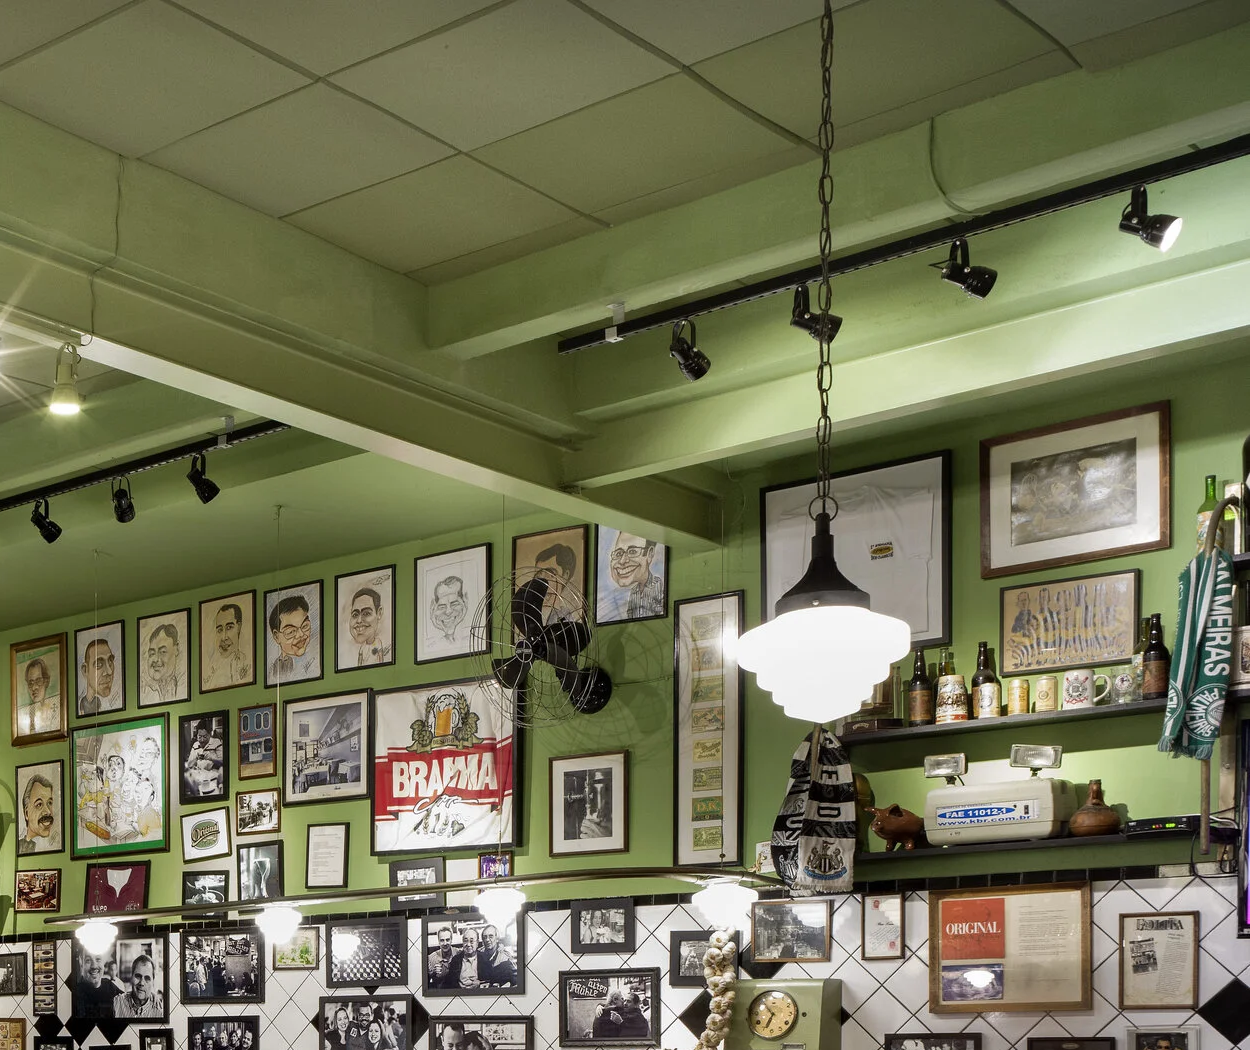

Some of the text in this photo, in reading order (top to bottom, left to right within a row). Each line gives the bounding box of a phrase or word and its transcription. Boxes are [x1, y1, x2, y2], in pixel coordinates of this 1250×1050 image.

[945, 807, 1007, 819] FAE 11012-1
[937, 815, 1031, 827] www.kbr.com.br
[945, 920, 1001, 936] ORIGINAL
